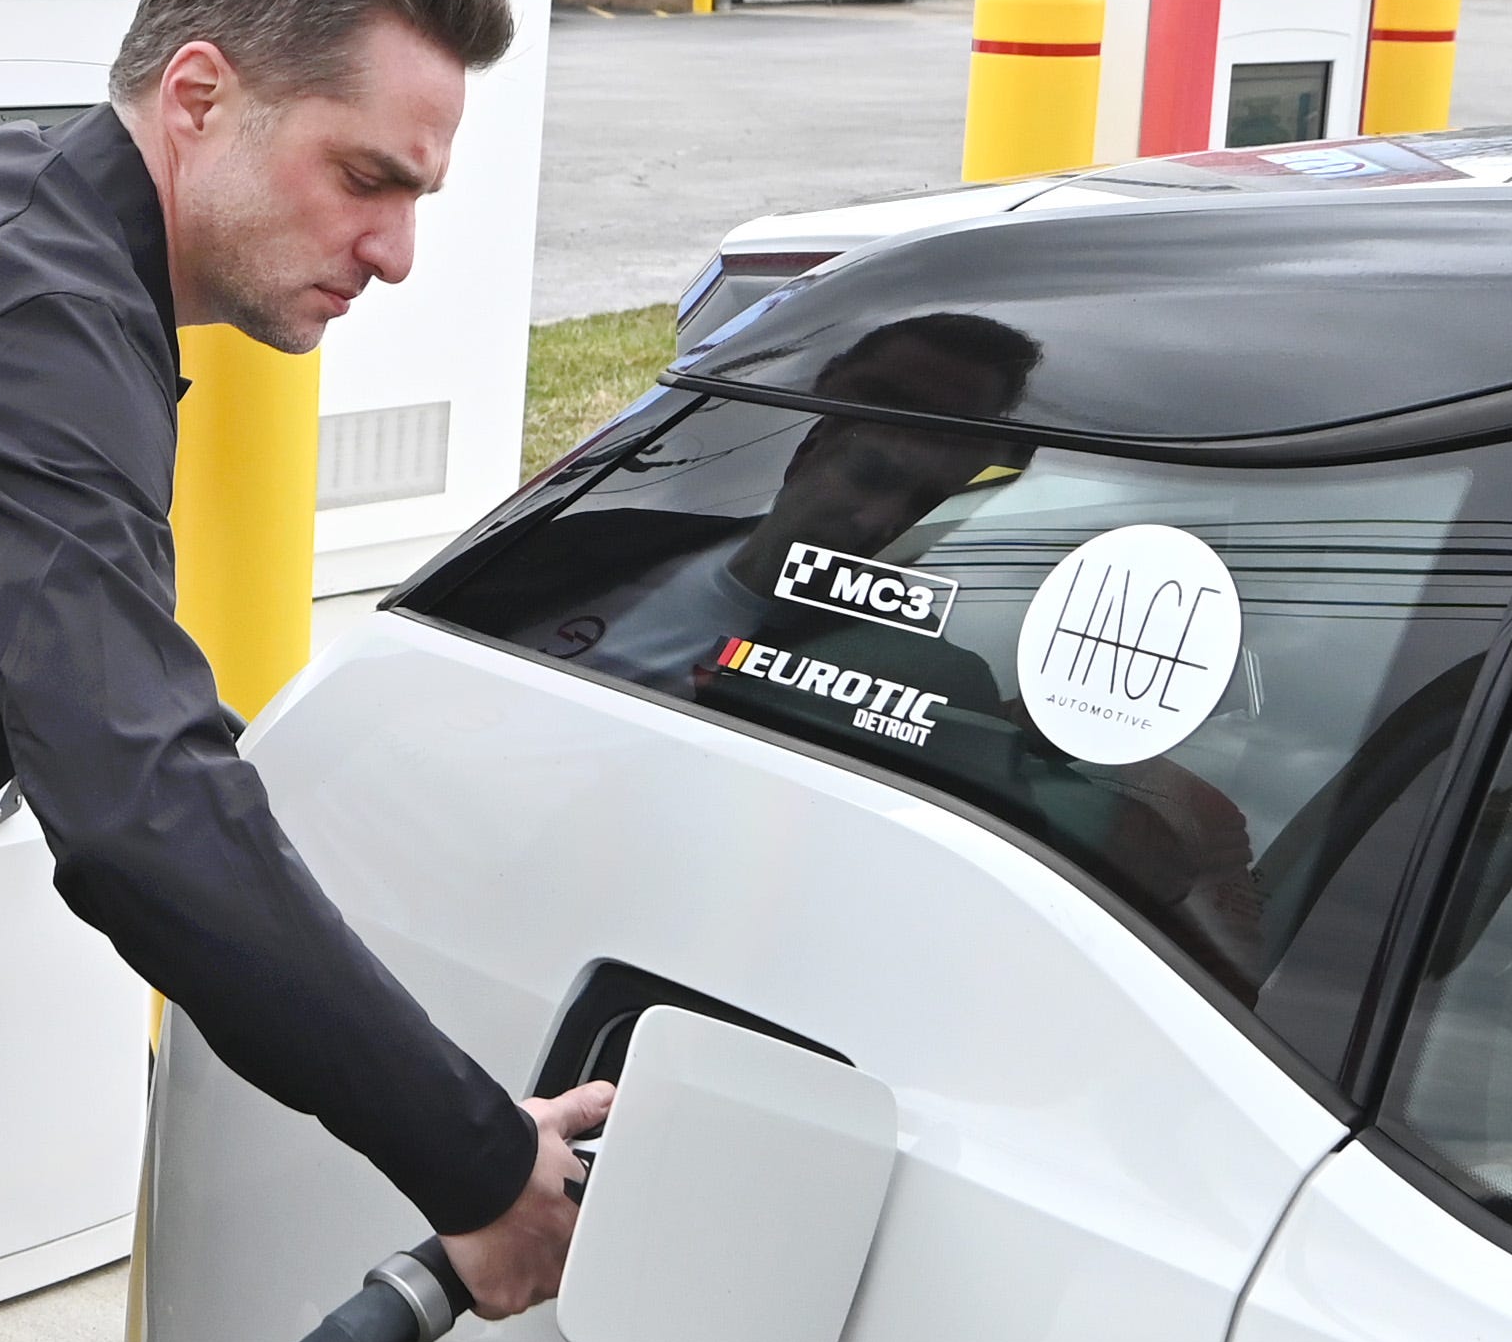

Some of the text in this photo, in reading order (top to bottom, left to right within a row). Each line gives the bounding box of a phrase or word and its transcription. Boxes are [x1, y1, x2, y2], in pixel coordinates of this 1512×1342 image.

[829, 566, 935, 620] MC3
[739, 643, 949, 728] EUROTIC
[852, 708, 932, 747] DETROIT
[1045, 693, 1153, 730] AUTOMOTIVE
